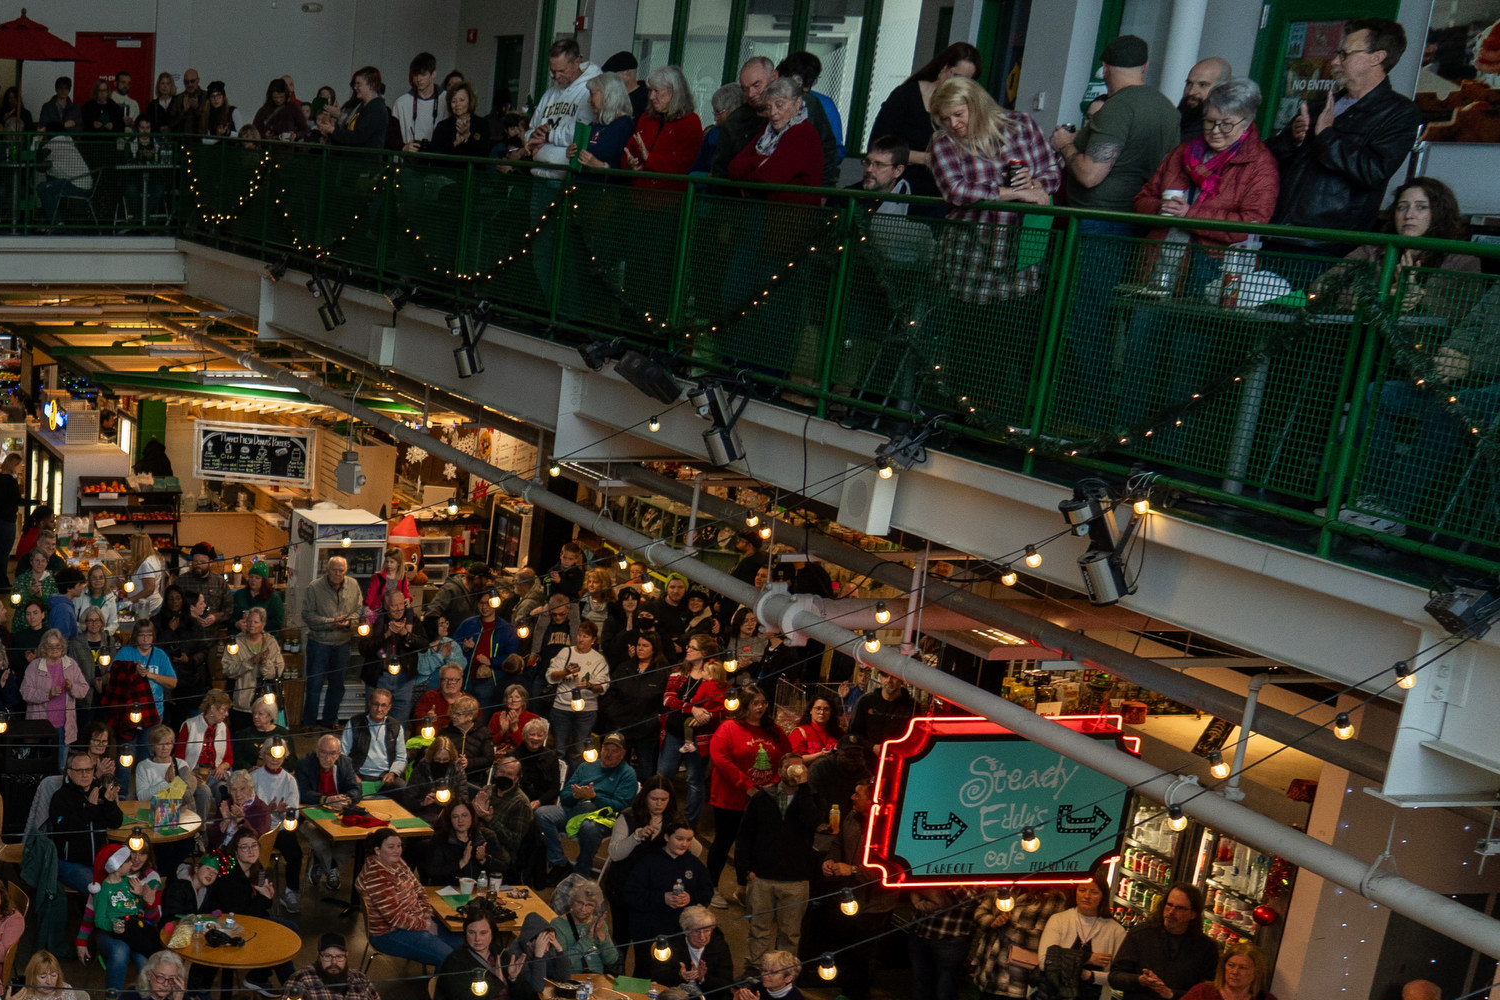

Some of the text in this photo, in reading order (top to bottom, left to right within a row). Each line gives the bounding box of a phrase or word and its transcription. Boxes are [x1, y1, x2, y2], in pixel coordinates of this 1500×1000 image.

[1292, 79, 1337, 91] NO ENTRY
[959, 755, 1080, 807] Steady
[979, 803, 1048, 842] Eddy's
[926, 862, 974, 874] TAKE OUT
